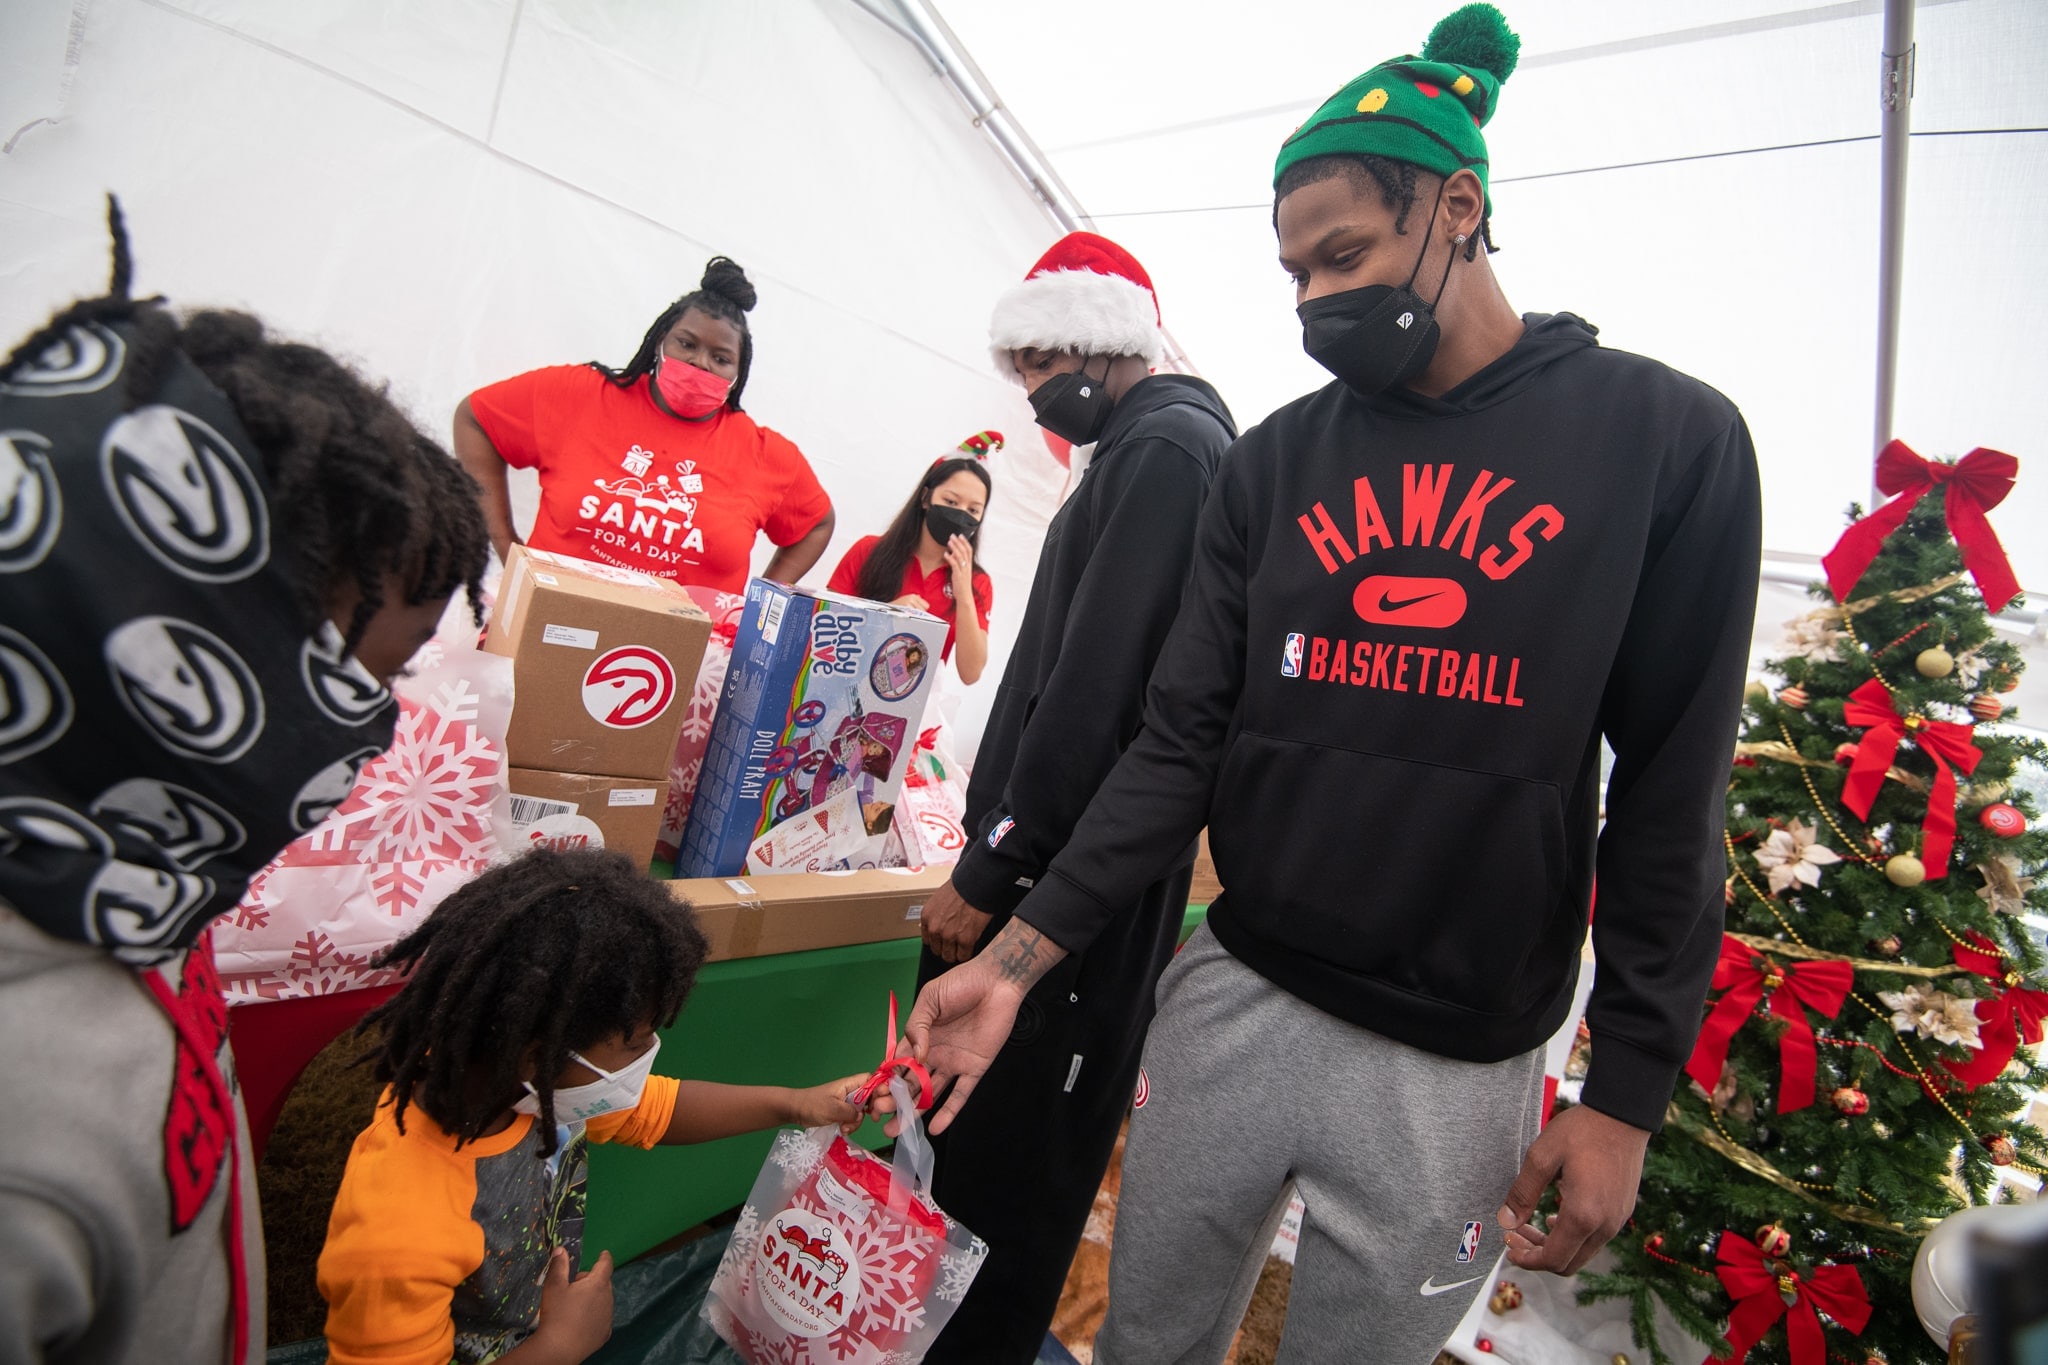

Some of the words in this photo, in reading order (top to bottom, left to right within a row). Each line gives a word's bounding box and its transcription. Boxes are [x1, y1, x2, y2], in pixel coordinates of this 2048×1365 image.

[579, 495, 704, 553] SANTA
[594, 528, 626, 547] FOR
[630, 541, 642, 553] A
[647, 545, 681, 563] DAY
[1297, 464, 1565, 580] HAWKS
[590, 544, 677, 577] SANTAFORADAY.ORG
[834, 616, 863, 674] baby
[1308, 637, 1524, 707] BASKETBALL
[750, 731, 776, 760] DOLL
[739, 766, 767, 798] PRAM
[763, 1234, 844, 1316] SANTA
[766, 1268, 786, 1292] FOR
[788, 1290, 796, 1300] A
[799, 1296, 824, 1318] DAY
[761, 1279, 818, 1331] SANTAFORADAY.ORG
